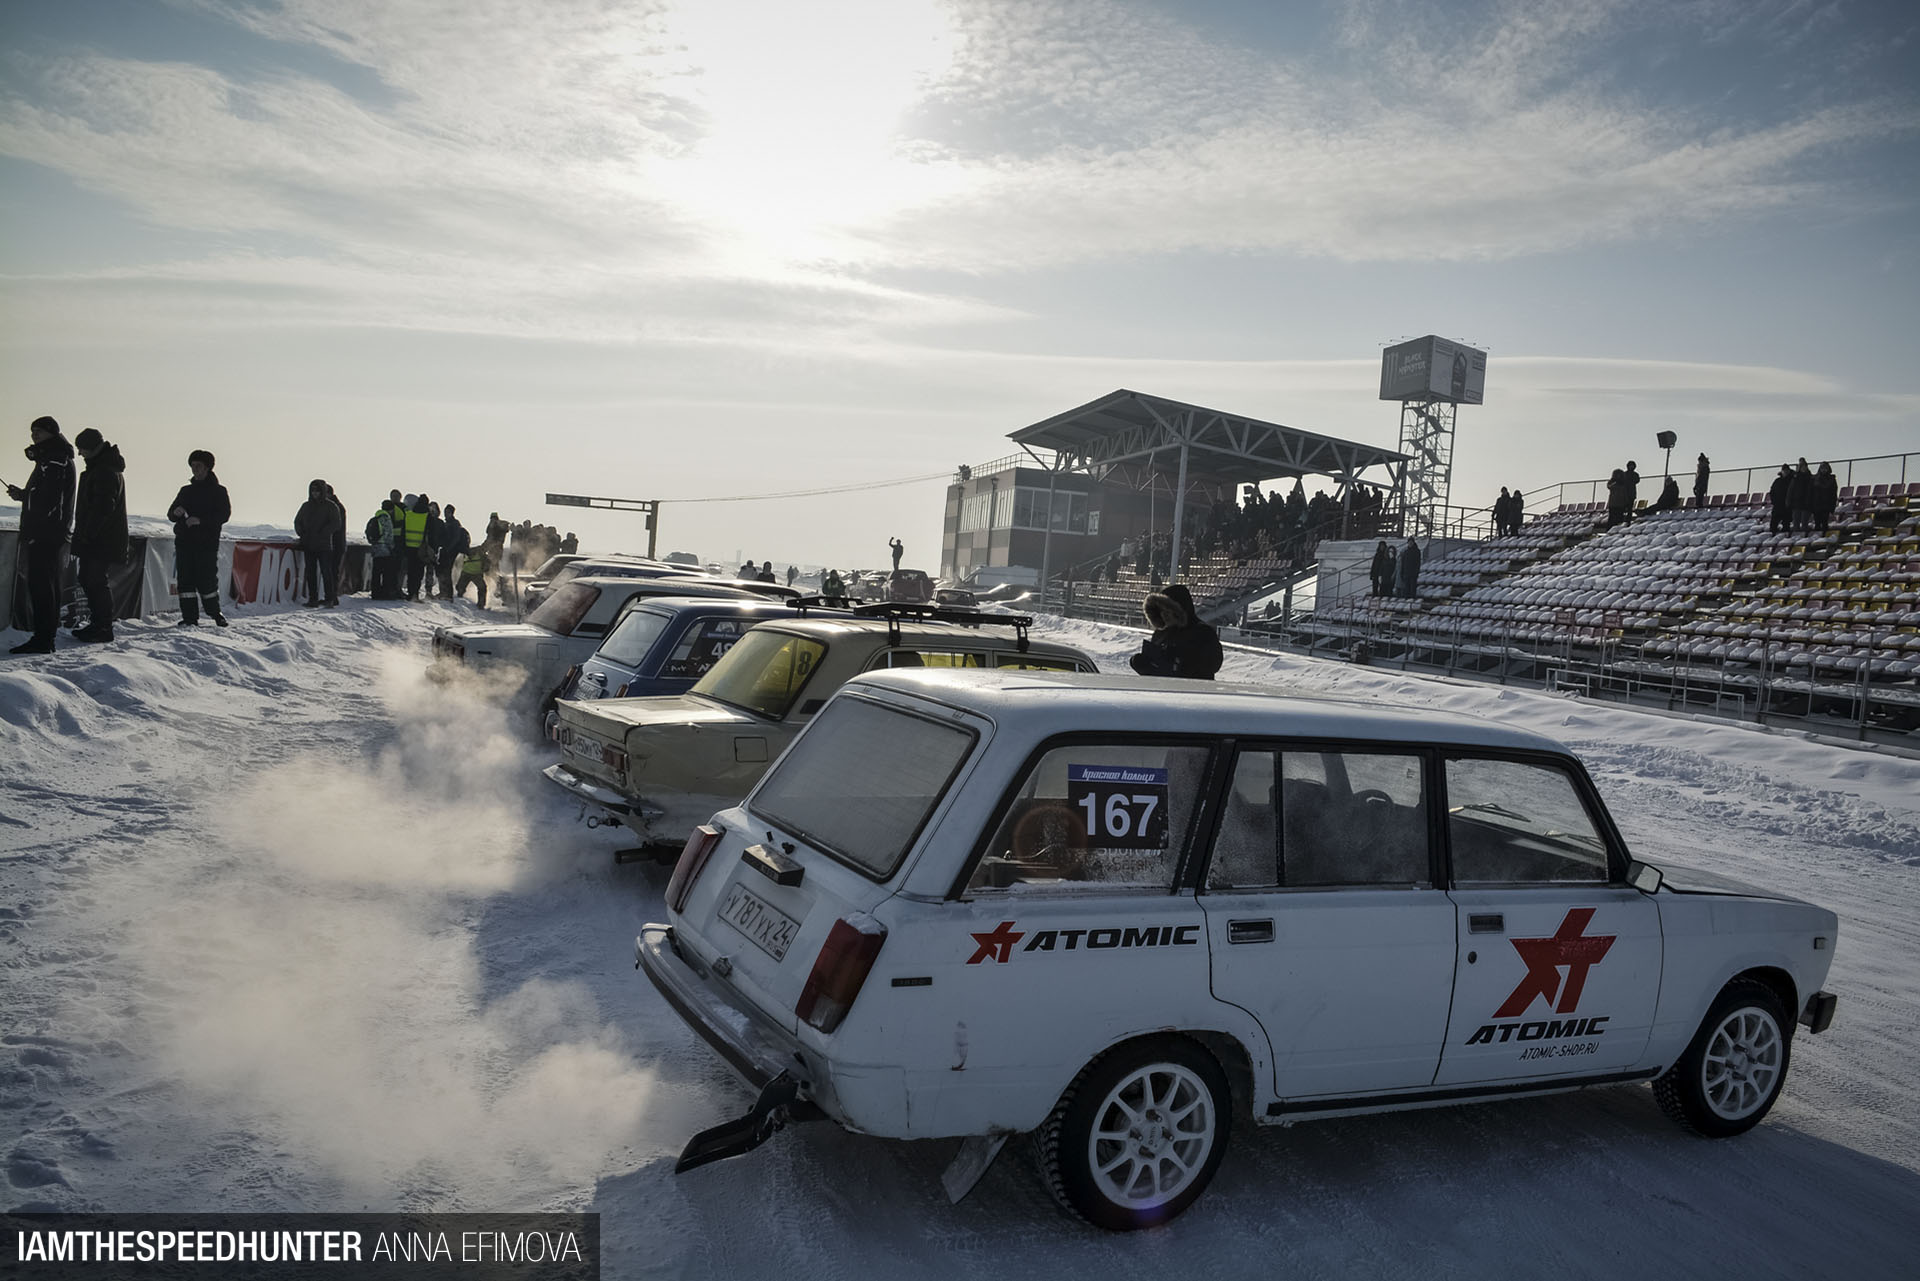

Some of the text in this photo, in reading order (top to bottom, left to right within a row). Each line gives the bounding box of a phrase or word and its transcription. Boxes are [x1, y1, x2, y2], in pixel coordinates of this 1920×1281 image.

[1079, 792, 1159, 838] 167
[1022, 925, 1200, 952] ATOMIC
[1464, 1016, 1610, 1046] ATOMIC
[1519, 1042, 1599, 1061] ATOMIC-SHOP.RU
